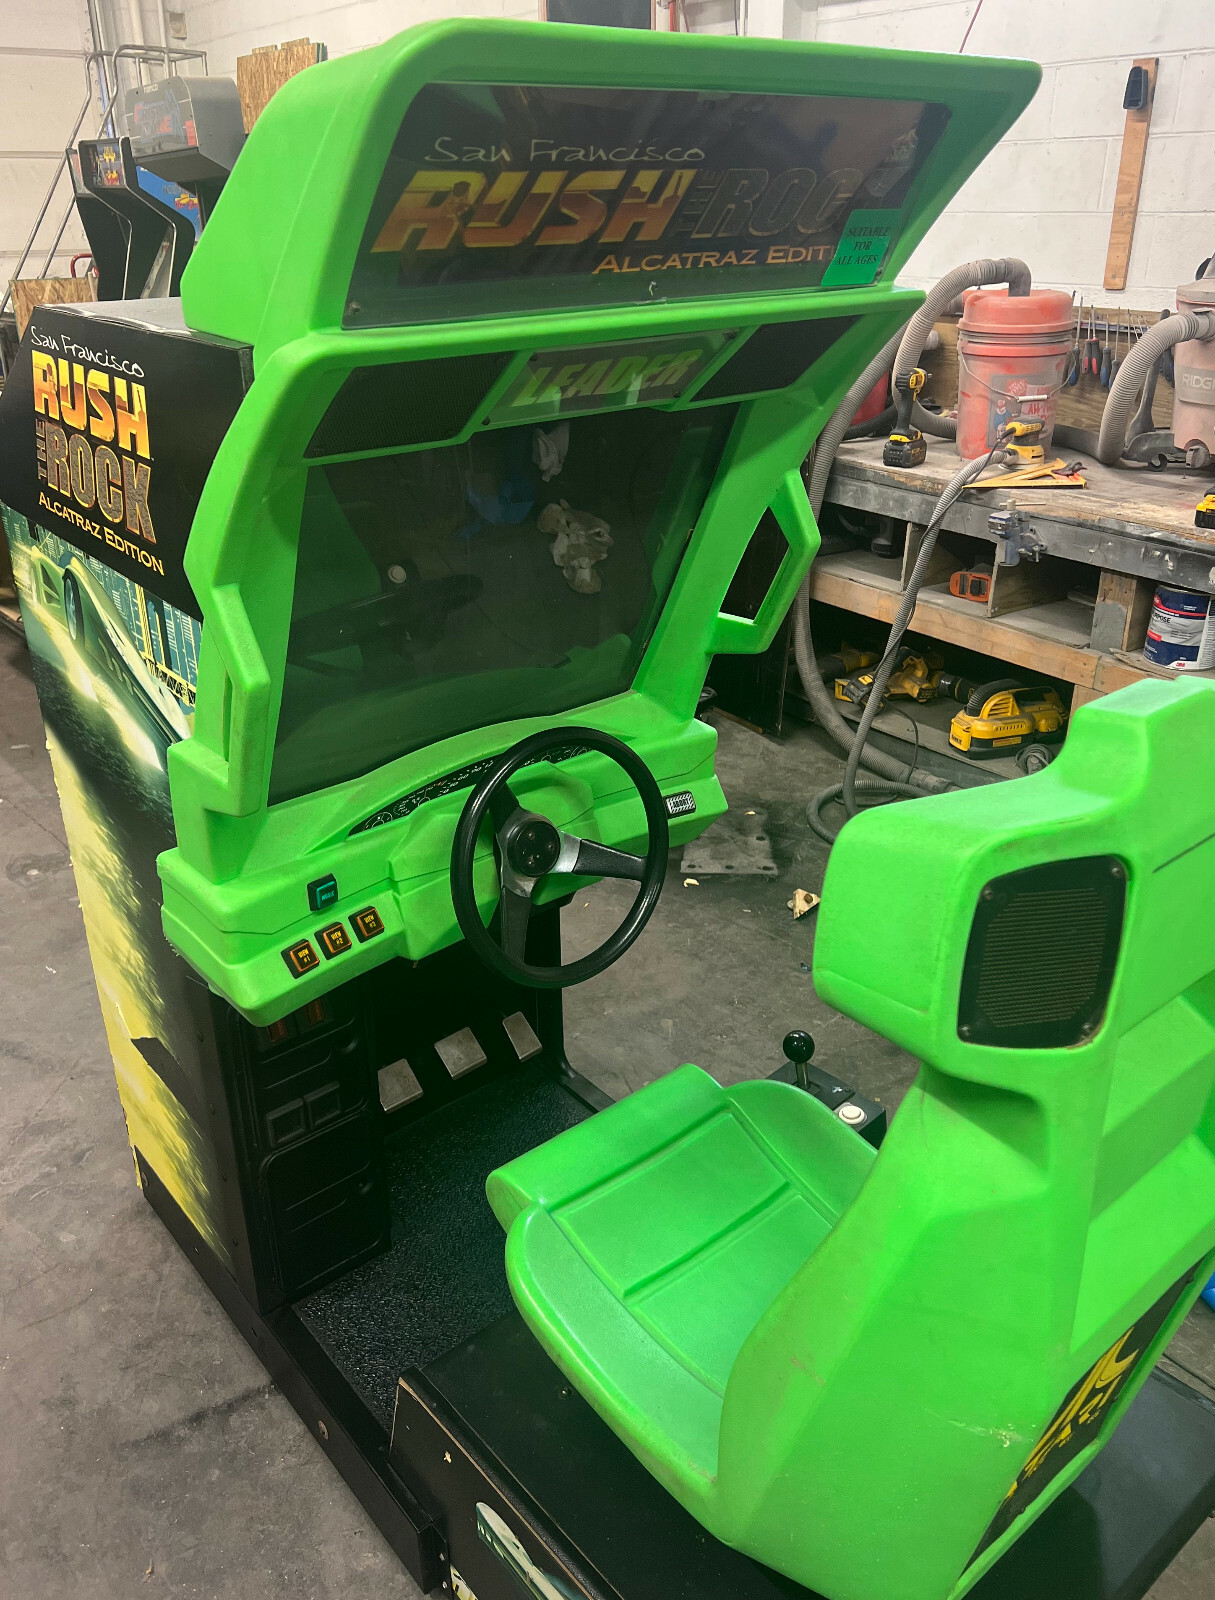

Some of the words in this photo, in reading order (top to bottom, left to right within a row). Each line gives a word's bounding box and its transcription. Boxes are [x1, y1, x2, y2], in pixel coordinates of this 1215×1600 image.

[425, 138, 510, 163] San
[530, 138, 705, 163] Francisco
[370, 168, 698, 253] RUSH
[690, 167, 864, 239] ROC
[848, 227, 889, 237] SUITABLE
[592, 249, 758, 275] ALCATRAZ
[766, 244, 837, 265] EDITI
[836, 255, 853, 265] ALL
[853, 254, 879, 265] AGES
[853, 240, 873, 251] FOR
[30, 326, 59, 352] San
[61, 335, 145, 378] Francisco
[509, 349, 704, 407] LEADER
[31, 349, 151, 460] RUSH
[35, 417, 47, 481] THE
[45, 422, 157, 544] ROCK
[38, 491, 102, 540] ALCATRAZ
[105, 529, 165, 576] EDITION
